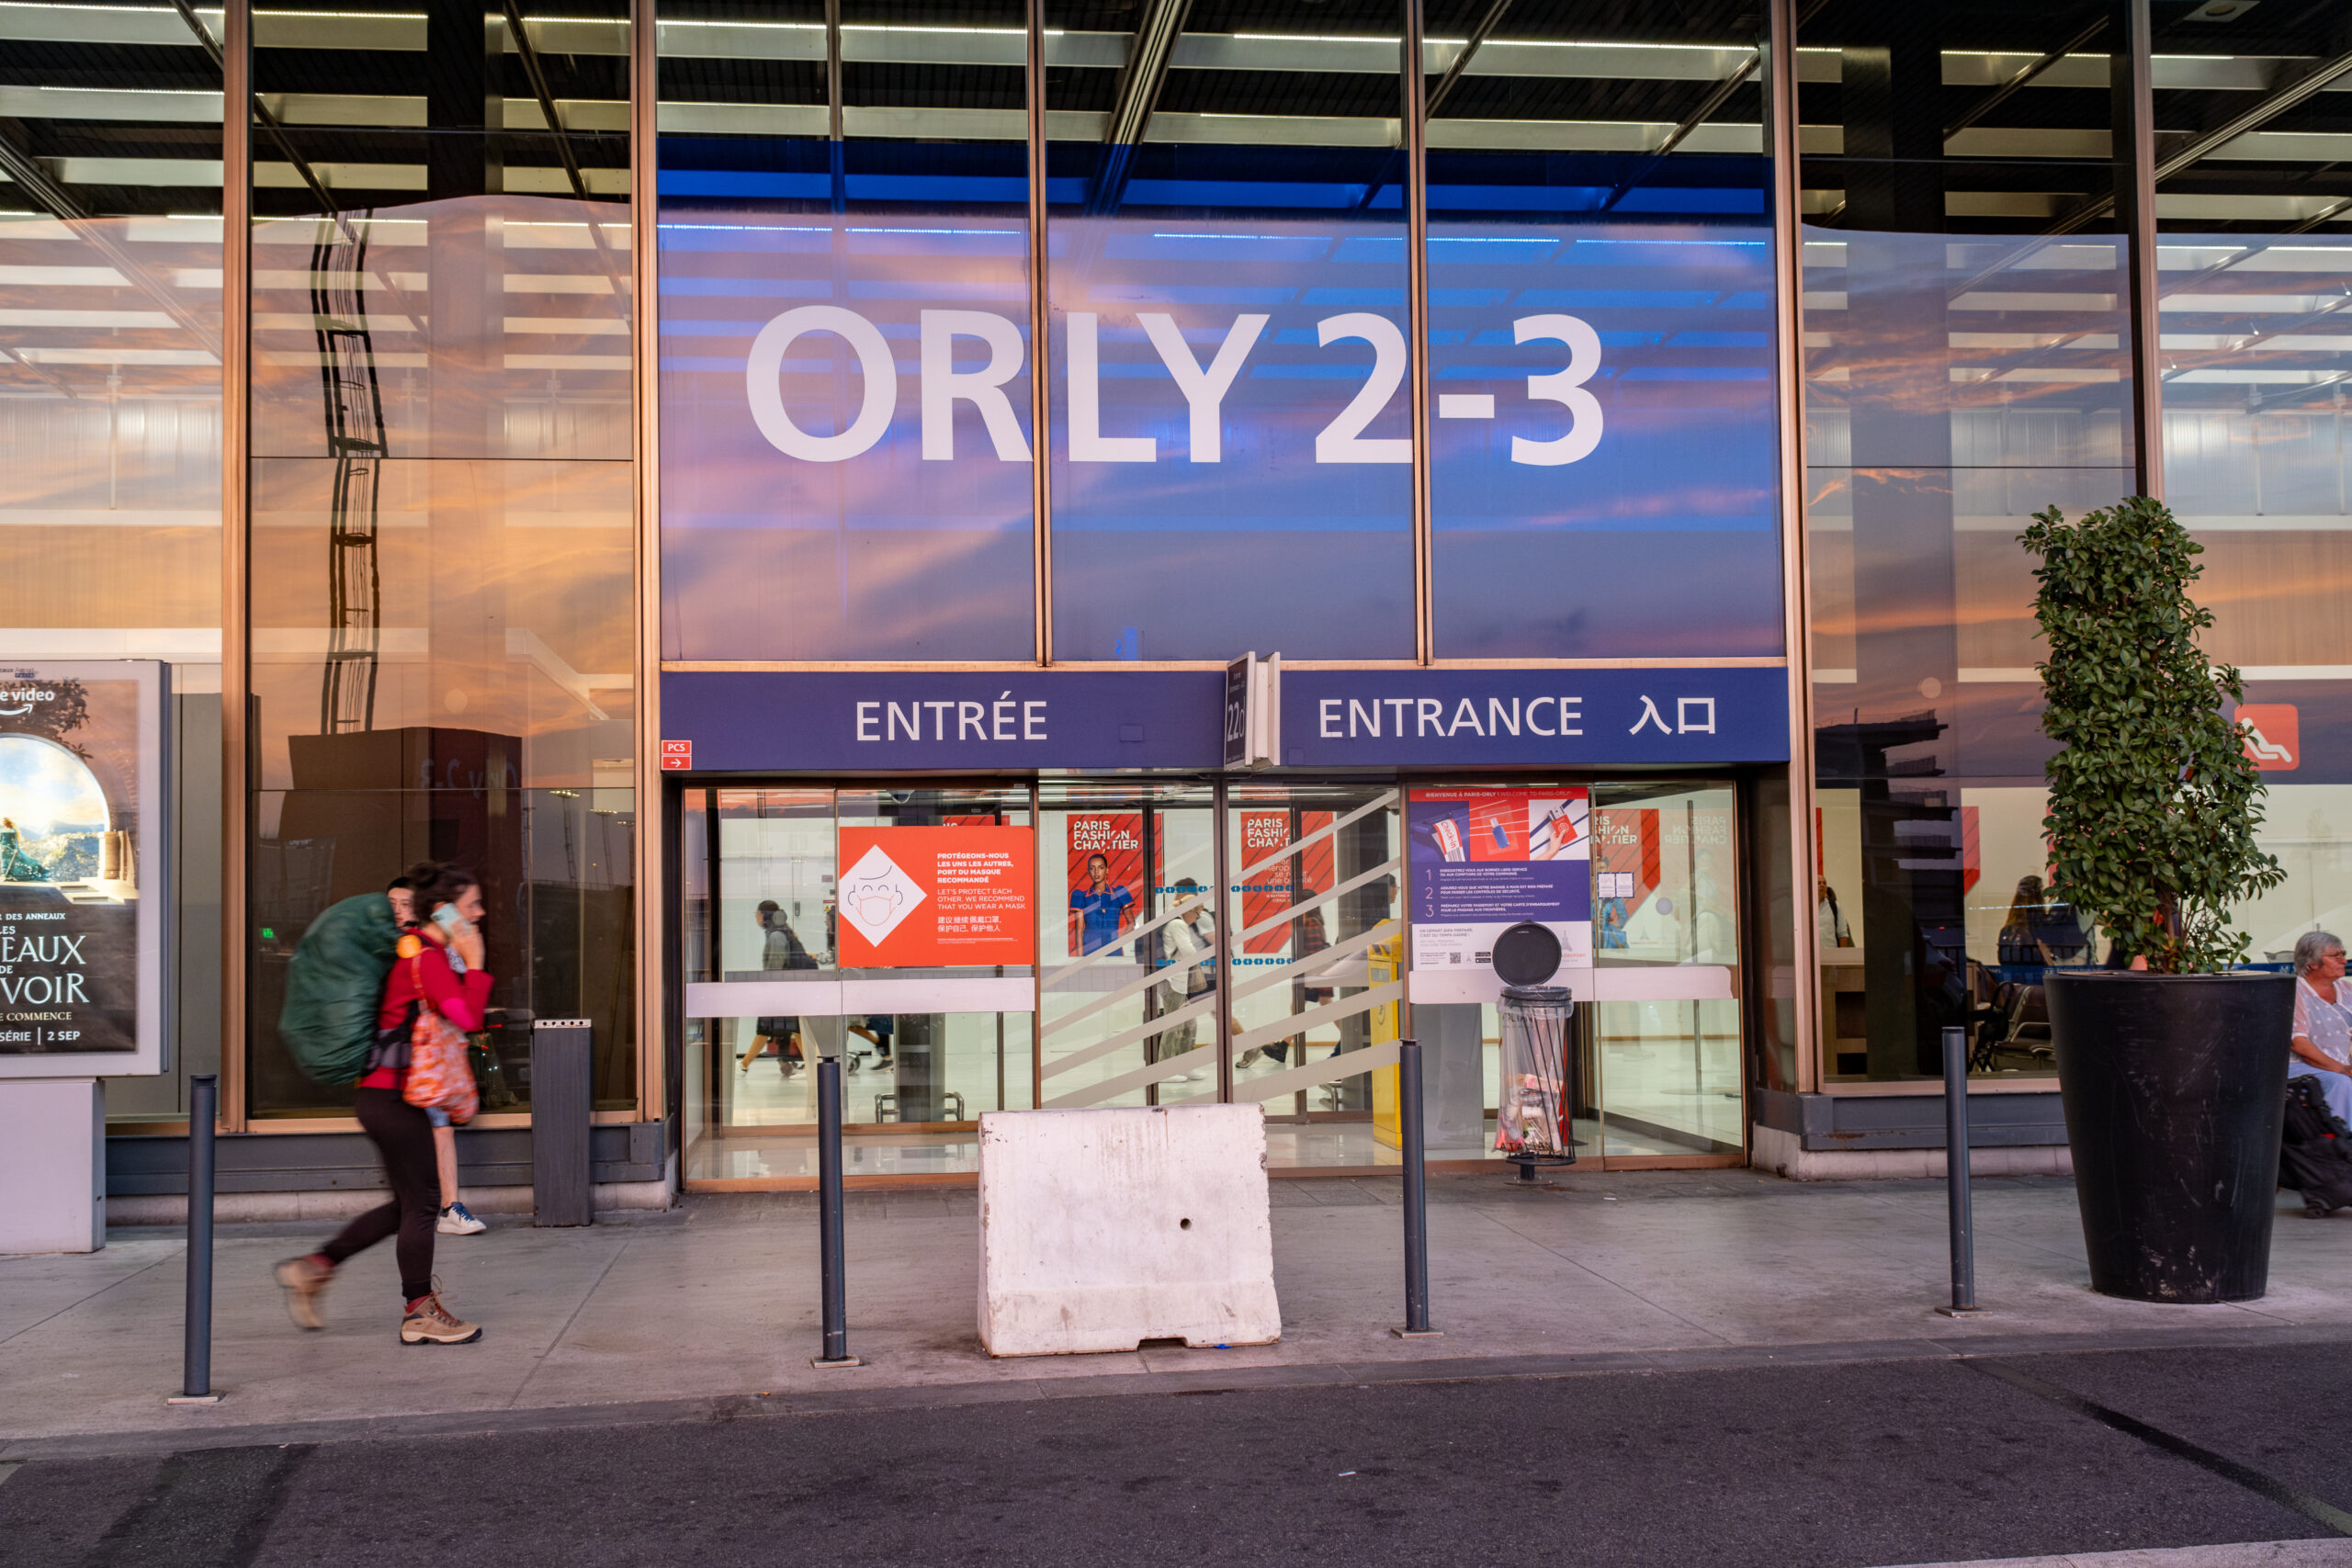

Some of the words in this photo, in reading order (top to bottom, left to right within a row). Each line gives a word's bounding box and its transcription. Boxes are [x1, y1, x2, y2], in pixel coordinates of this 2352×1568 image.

[745, 304, 1271, 464] ORLY
[1315, 312, 1605, 467] 2-3
[11, 687, 55, 702] video
[855, 691, 1048, 741] ENTRÉE
[1319, 695, 1584, 738] ENTRANCE
[1628, 694, 1717, 736] 入口
[668, 743, 685, 752] PCS
[1073, 820, 1111, 830] PARIS
[1248, 818, 1283, 828] PARIS
[1073, 829, 1131, 840] FASHION
[1441, 821, 1457, 849] Check-in
[1248, 837, 1290, 848] CHANT
[1425, 886, 1433, 899] 2
[26, 912, 66, 920] ANNEAUX
[1425, 904, 1434, 918] 3
[2, 935, 87, 964] EAUX
[0, 965, 14, 975] DE
[0, 973, 90, 1005] VOIR
[6, 1011, 73, 1021] COMMENCE
[0, 1030, 31, 1042] SÉRIE
[47, 1031, 55, 1041] 2
[58, 1031, 81, 1041] SEP
